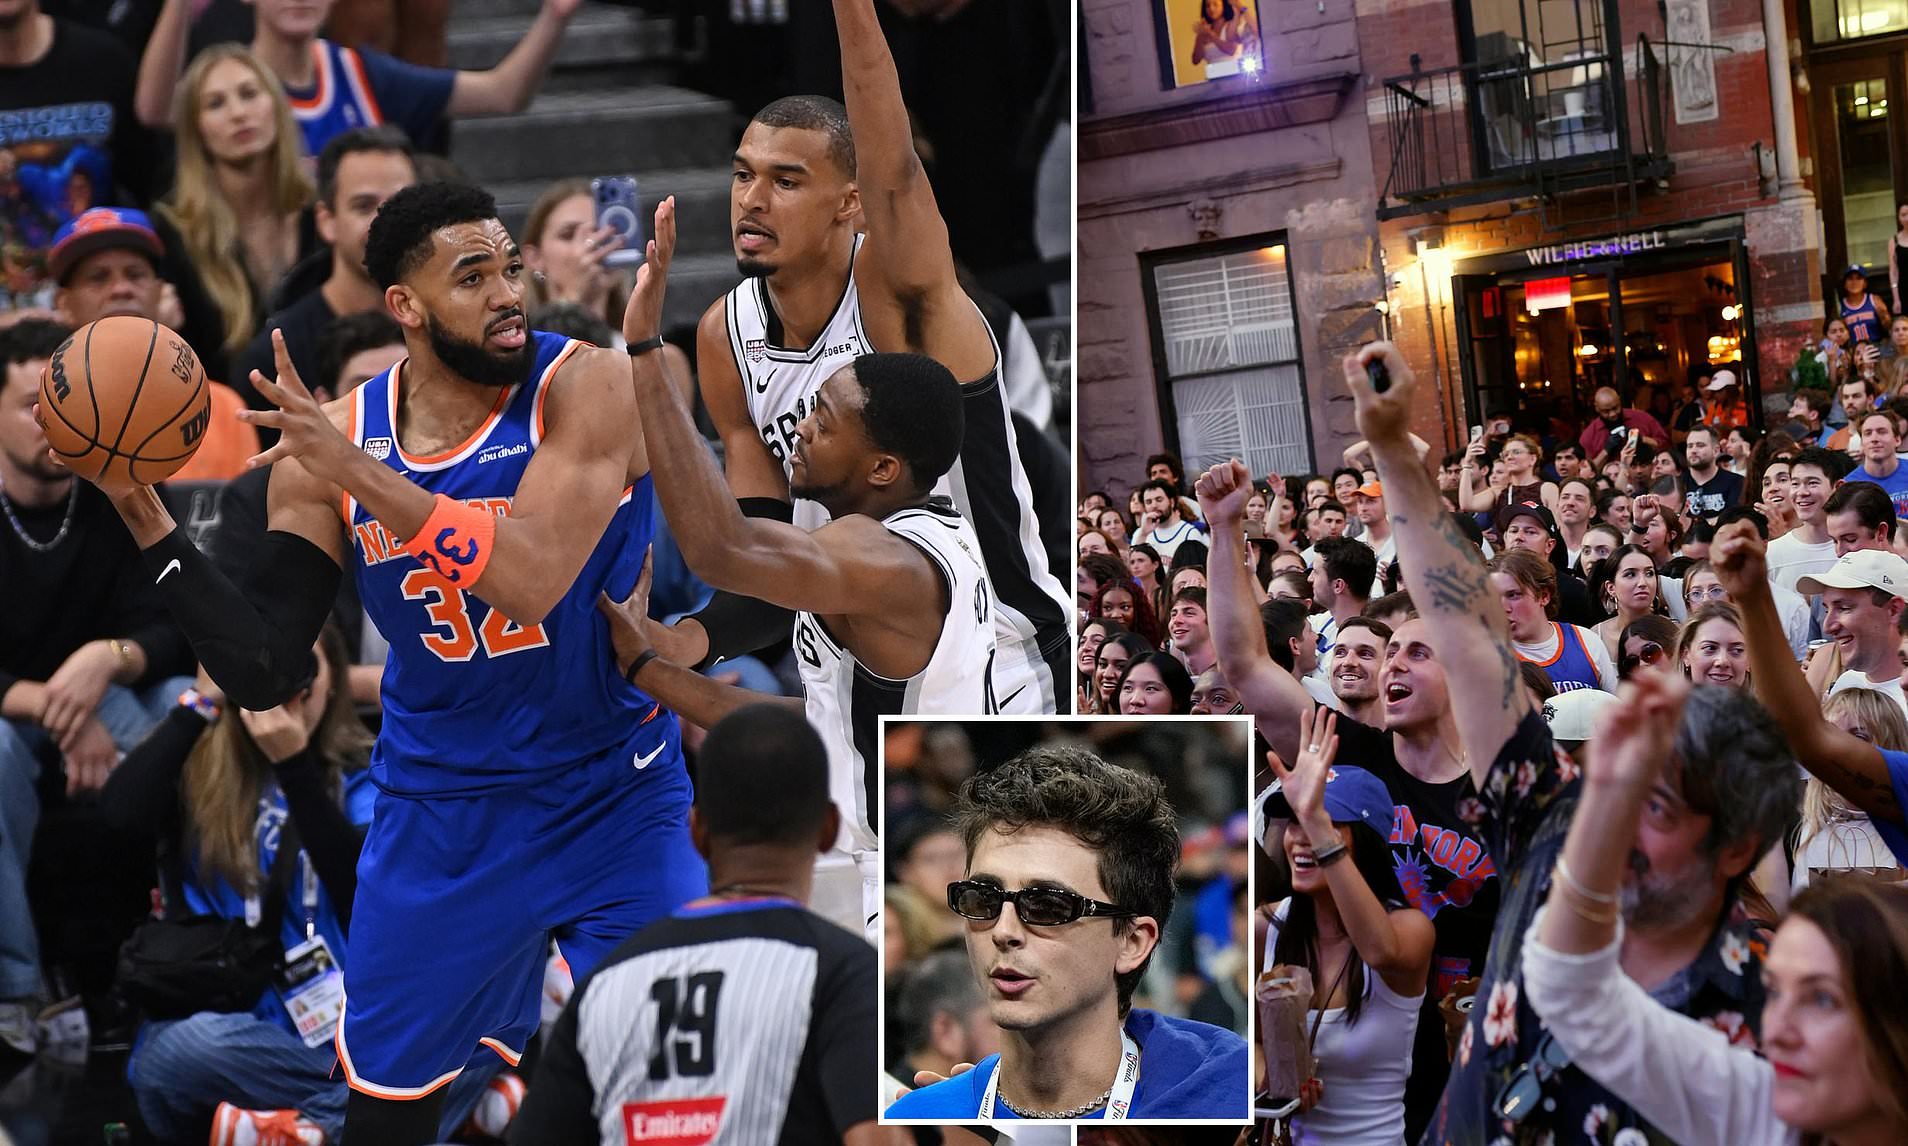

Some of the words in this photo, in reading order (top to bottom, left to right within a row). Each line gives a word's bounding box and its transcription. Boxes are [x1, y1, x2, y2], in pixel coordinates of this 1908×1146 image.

[1614, 231, 1666, 253] NELL
[822, 343, 852, 359] EDGER
[478, 452, 497, 464] abu
[497, 442, 528, 458] dhabi
[649, 970, 725, 1081] 19
[632, 1110, 719, 1142] Emirates
